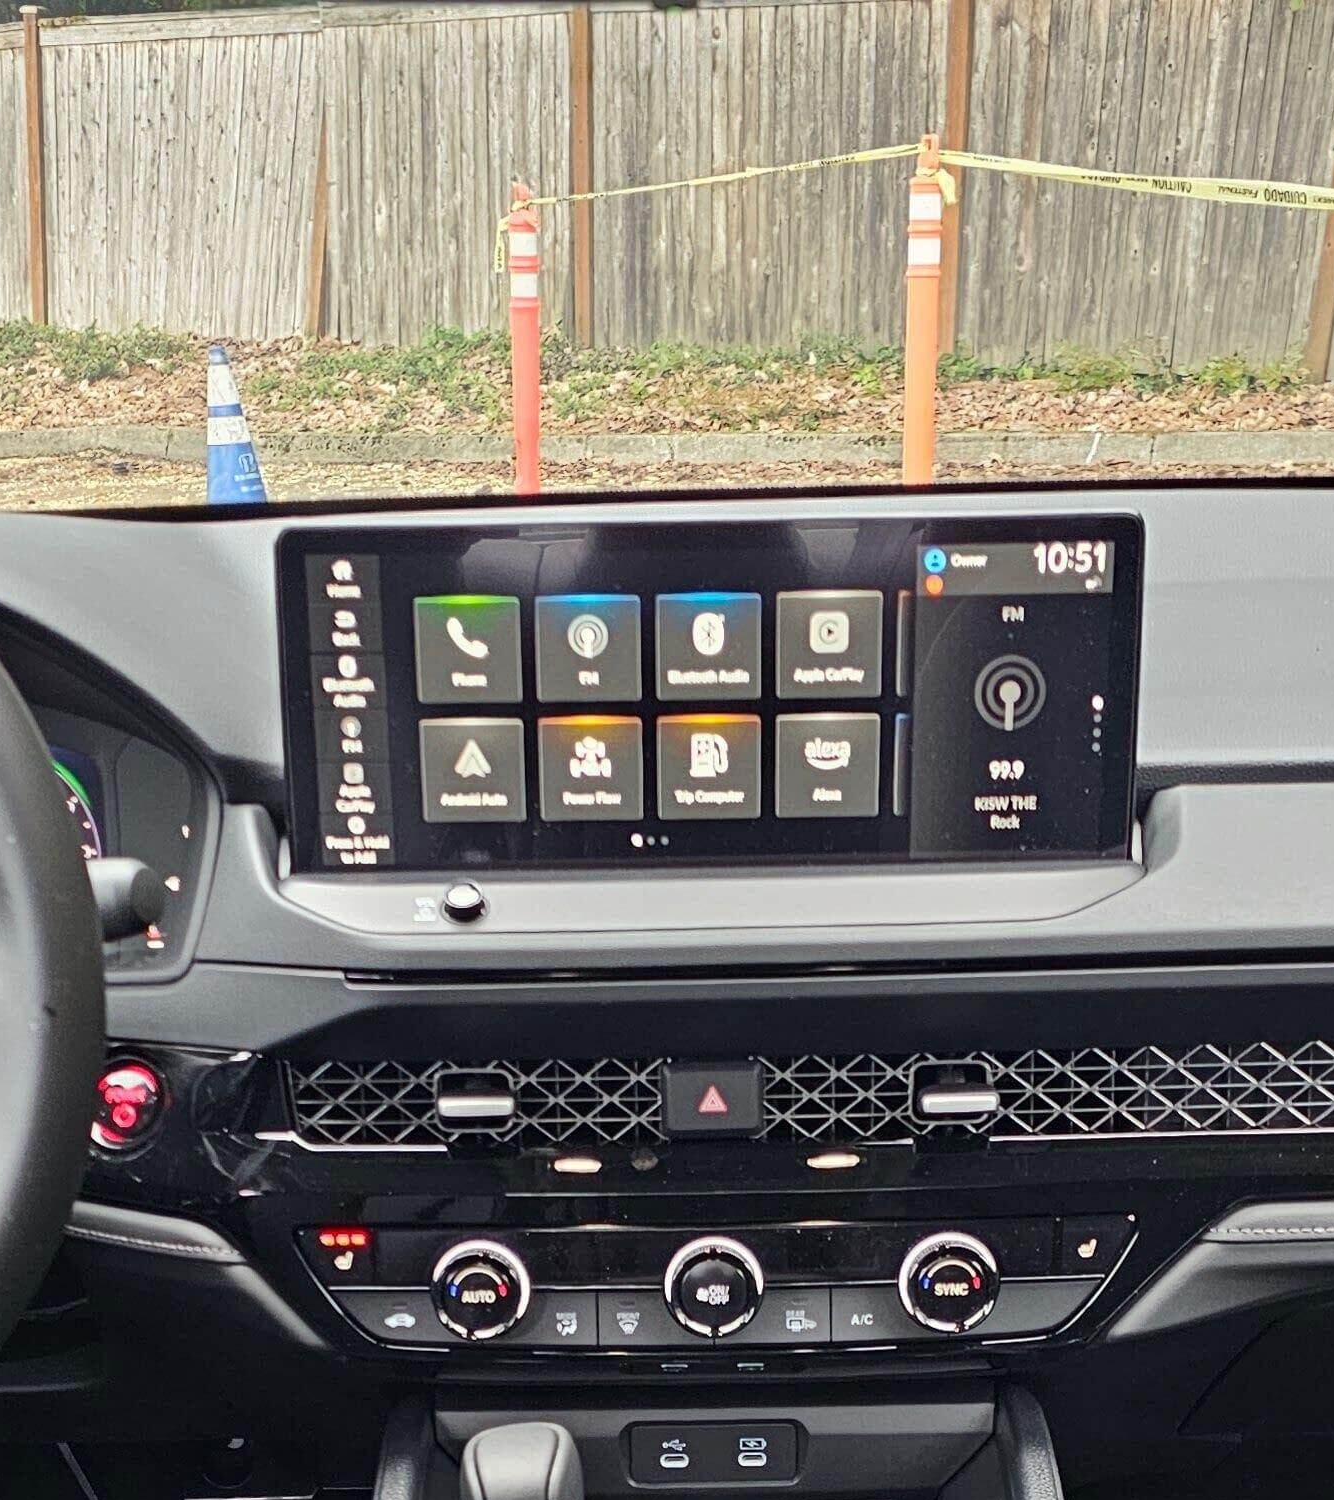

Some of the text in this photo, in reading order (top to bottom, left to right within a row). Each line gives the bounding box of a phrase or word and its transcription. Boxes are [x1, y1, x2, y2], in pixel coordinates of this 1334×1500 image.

[1151, 178, 1192, 194] CAUTION
[1264, 188, 1307, 204] CUIDADO
[1033, 540, 1107, 574] 10:51
[1001, 605, 1025, 622] FM
[578, 670, 600, 686] FM
[804, 737, 852, 760] alexa
[989, 759, 1025, 780] 99.9
[974, 795, 1037, 812] KISW THE
[990, 814, 1020, 830] Rock
[461, 1289, 497, 1304] AUTO
[933, 1282, 970, 1297] SYNC
[851, 1313, 874, 1326] A/C
